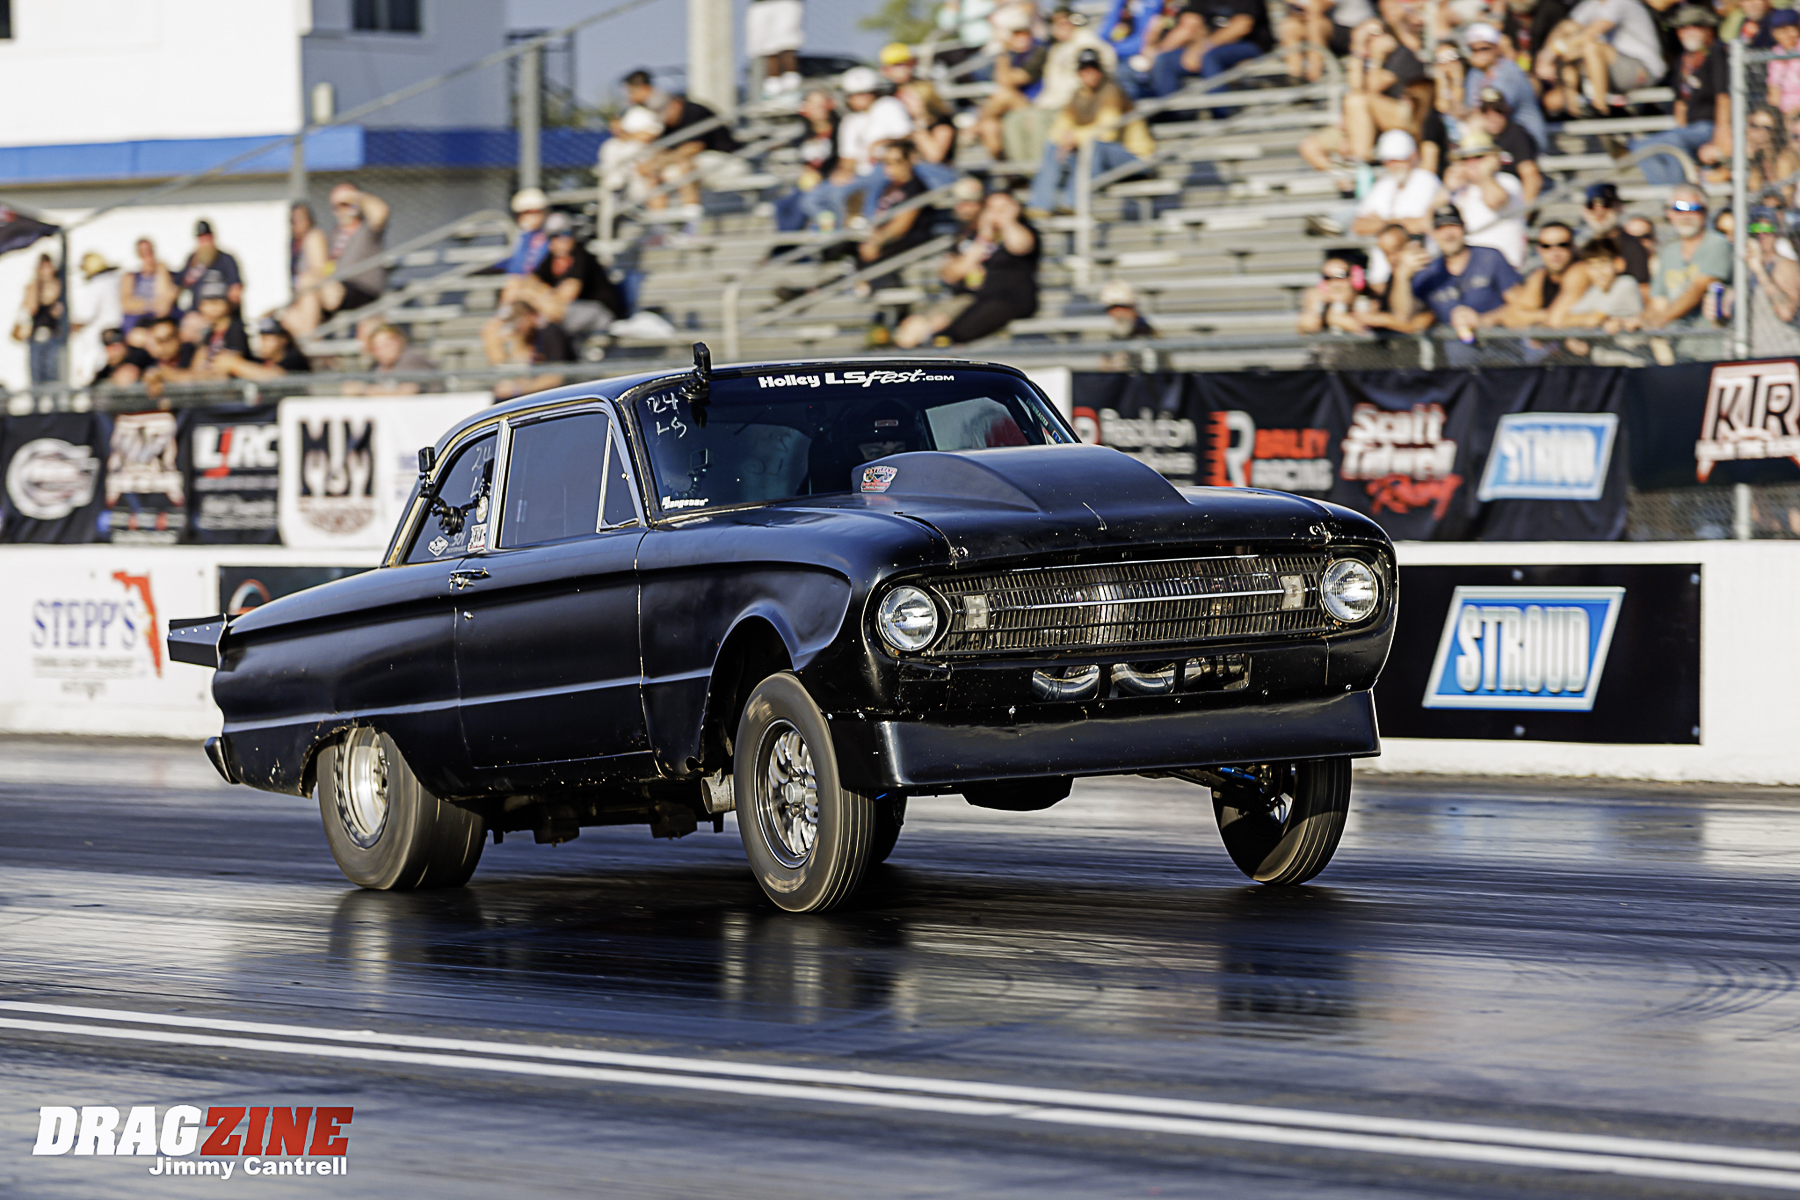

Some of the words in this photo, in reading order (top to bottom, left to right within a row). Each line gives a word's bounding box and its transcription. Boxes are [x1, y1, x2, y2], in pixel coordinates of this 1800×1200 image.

[758, 375, 821, 388] Holley
[646, 392, 680, 414] 24
[1456, 604, 1591, 693] STROUD
